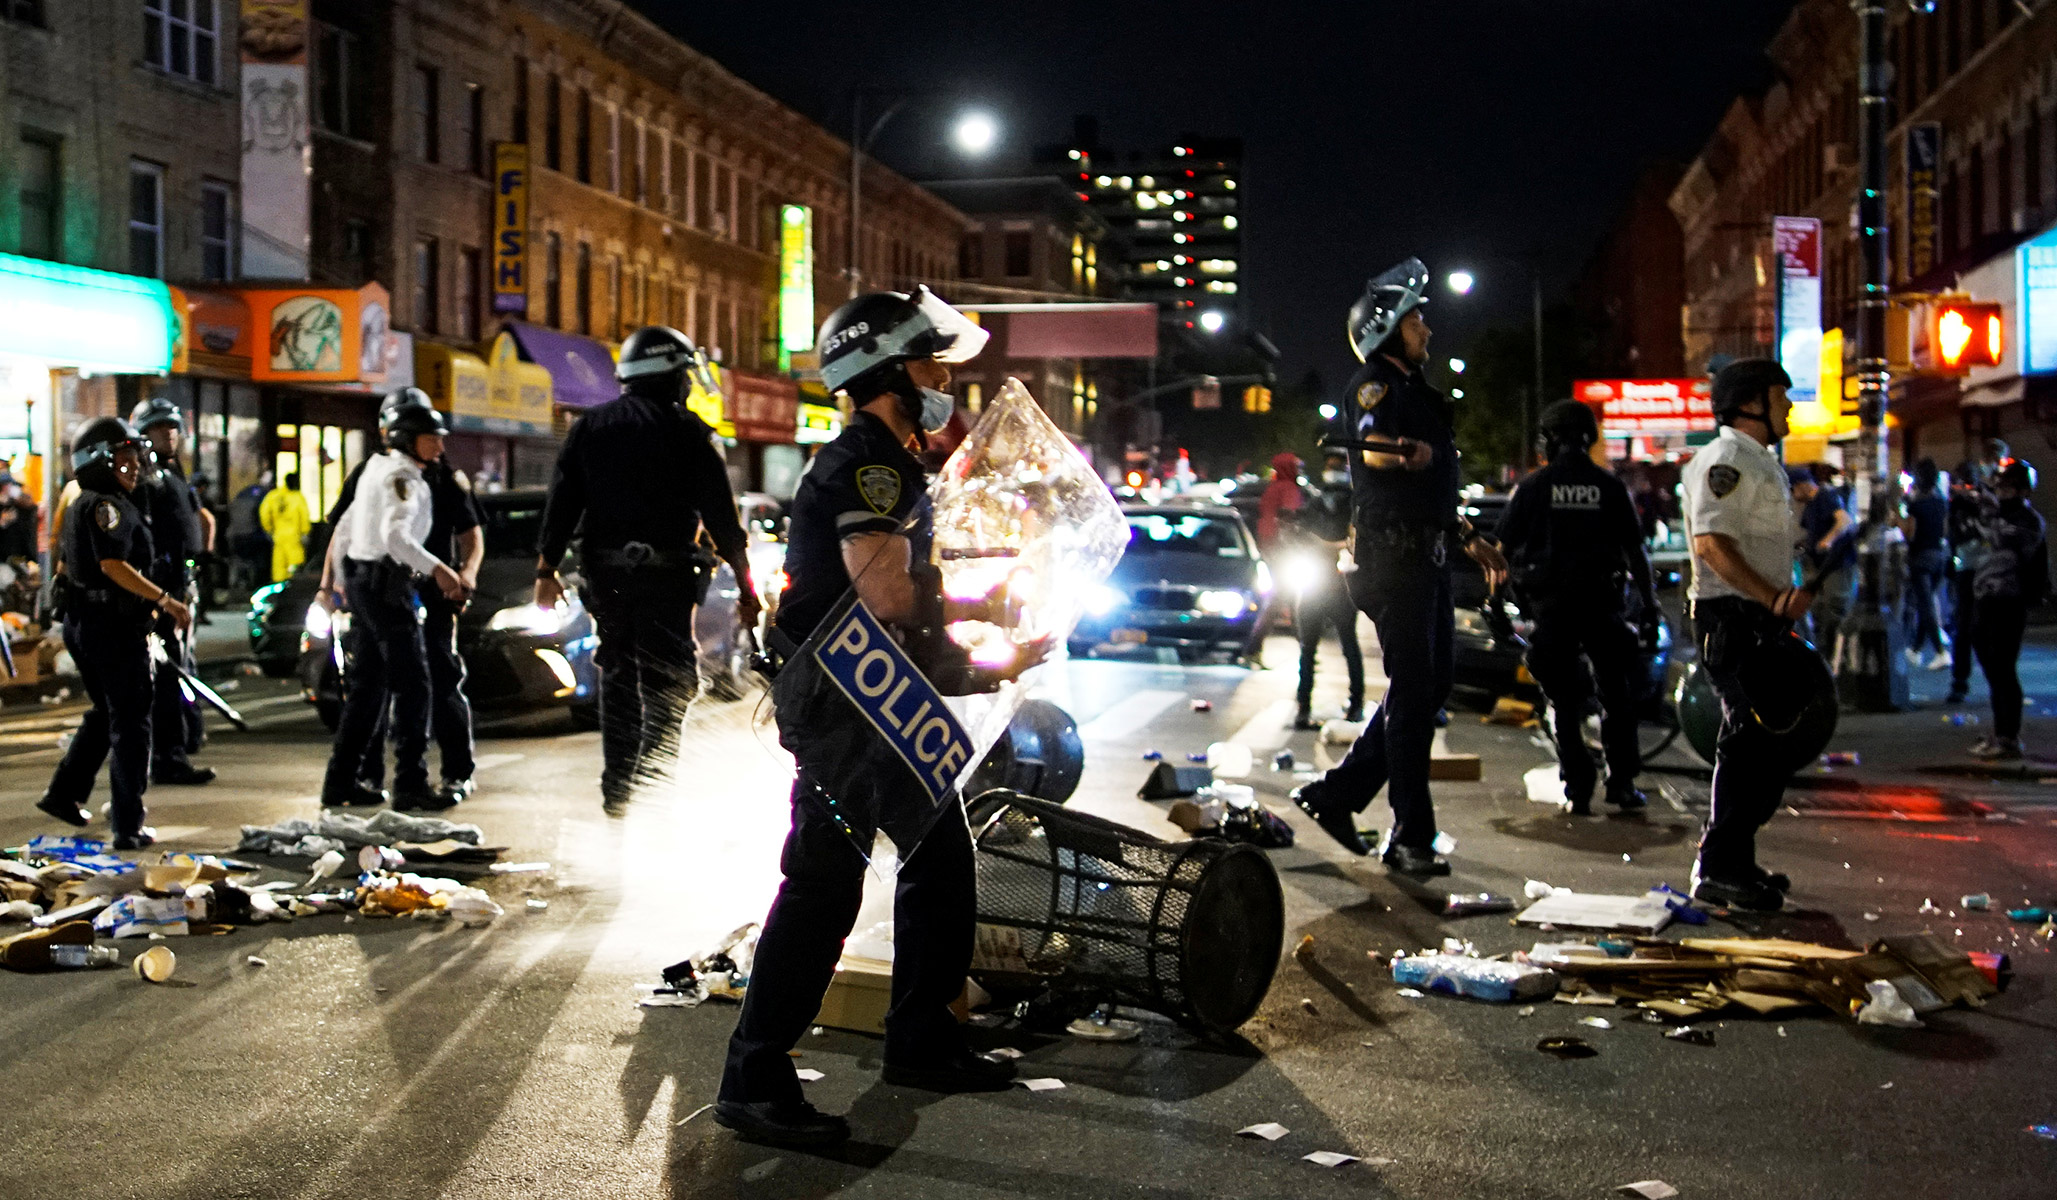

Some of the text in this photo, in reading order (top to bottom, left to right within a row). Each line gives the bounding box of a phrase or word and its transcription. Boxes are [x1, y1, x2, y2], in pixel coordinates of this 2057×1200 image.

[500, 169, 523, 287] FISH
[1552, 484, 1601, 503] NYPD
[827, 616, 967, 792] POLICE
